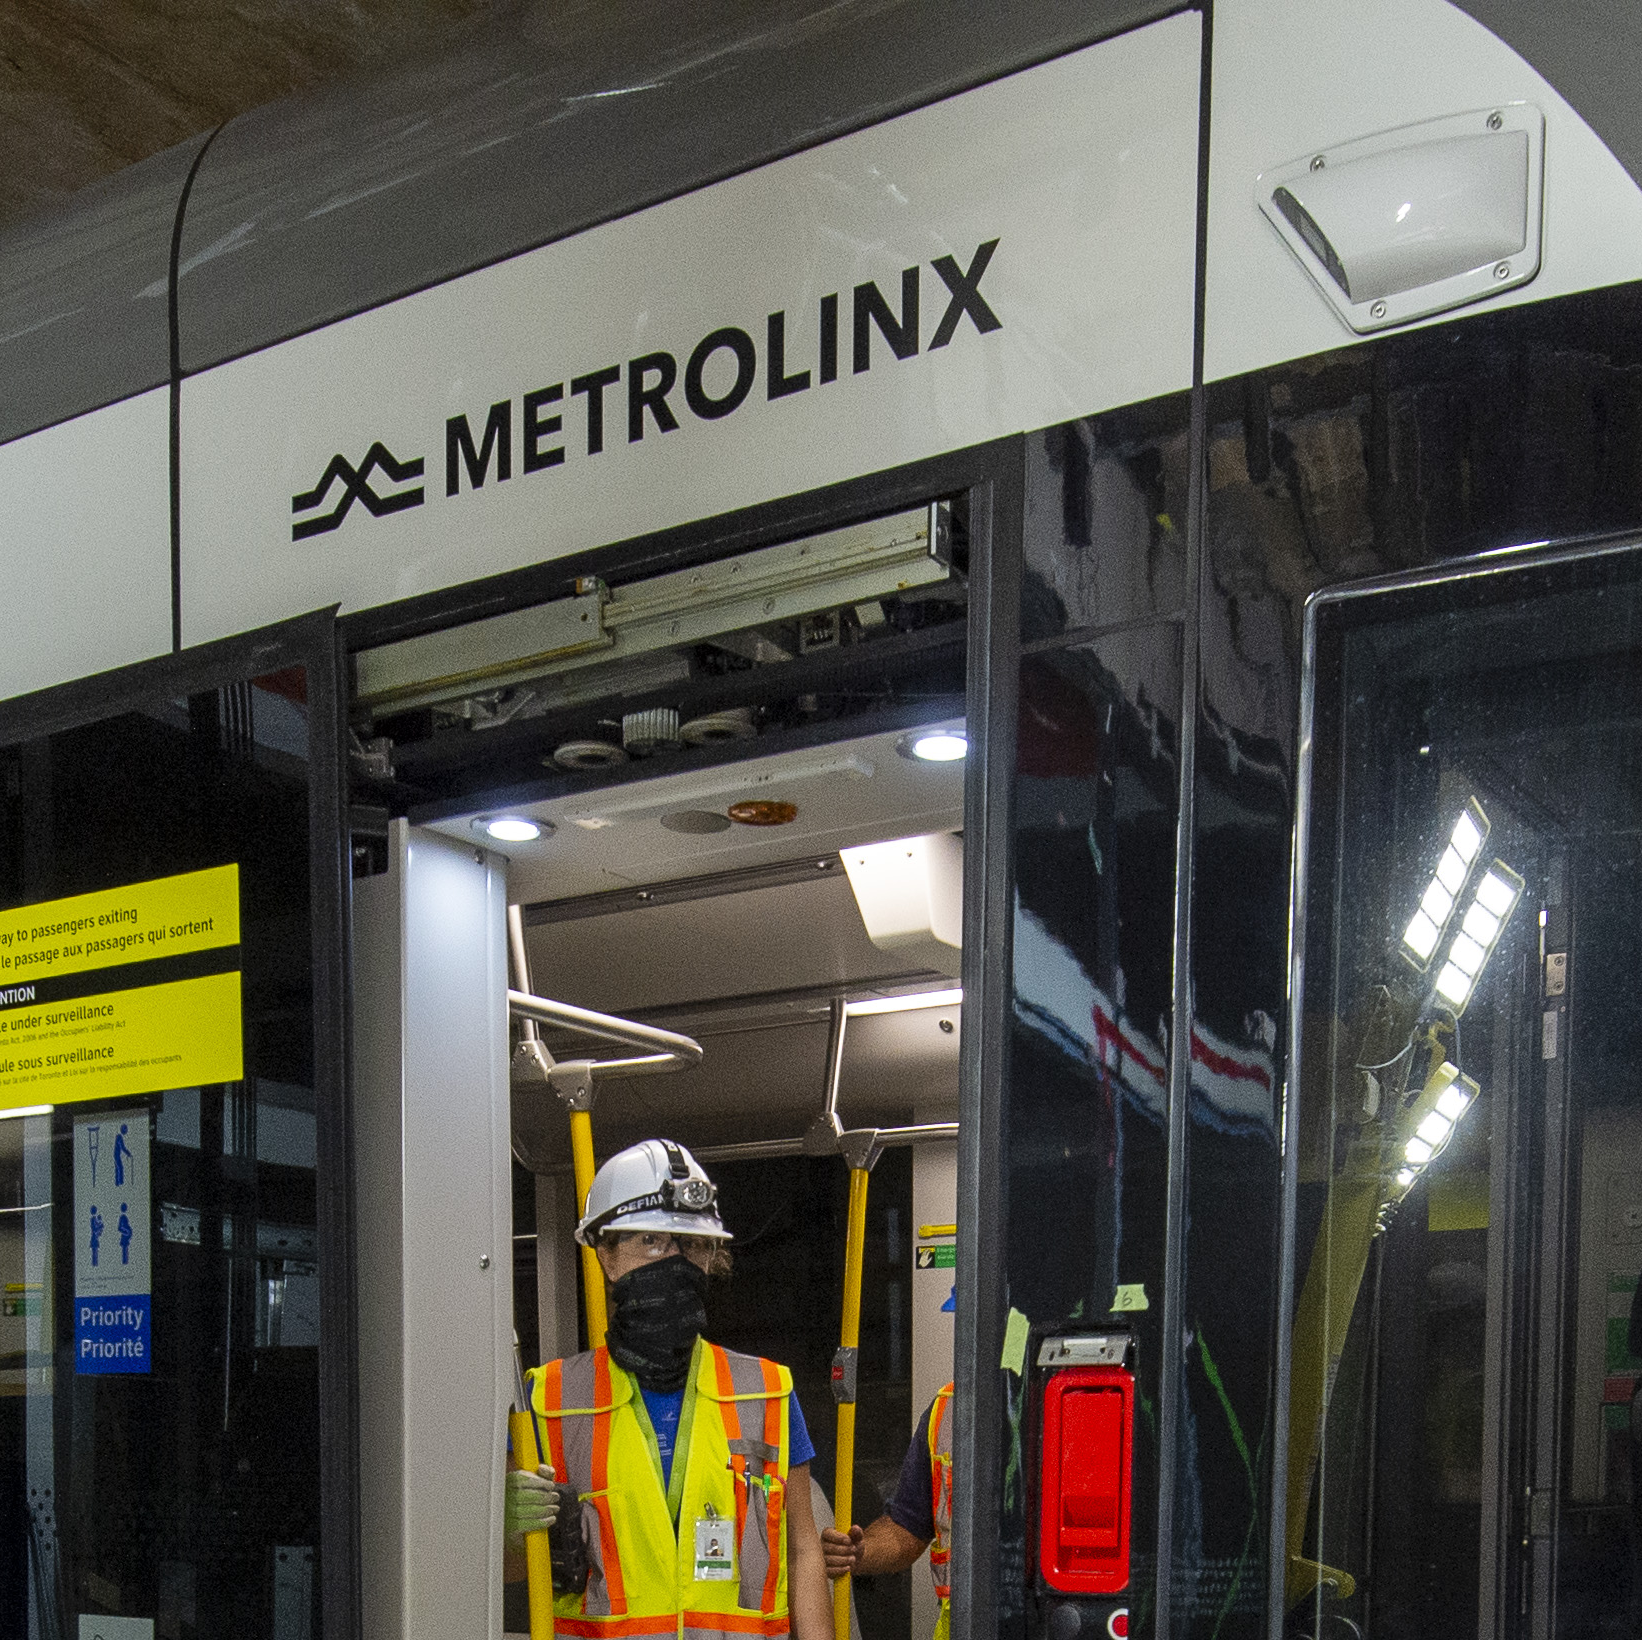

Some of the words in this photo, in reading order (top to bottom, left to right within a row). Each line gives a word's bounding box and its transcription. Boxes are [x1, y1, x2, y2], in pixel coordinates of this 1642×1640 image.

[445, 237, 1003, 497] METROLINX
[17, 930, 28, 941] to
[31, 917, 95, 942] passengers
[98, 908, 137, 926] exiting
[1, 955, 11, 968] le
[15, 948, 59, 969] passage
[63, 945, 83, 957] aux
[86, 932, 144, 957] passagers
[148, 926, 166, 945] qui
[169, 918, 213, 938] sortent
[11, 1014, 42, 1031] under
[46, 1005, 114, 1025] surveillance
[18, 1057, 43, 1070] sous
[46, 1046, 114, 1066] surveillance
[80, 1306, 143, 1330] Priority
[81, 1336, 144, 1358] Priorité
